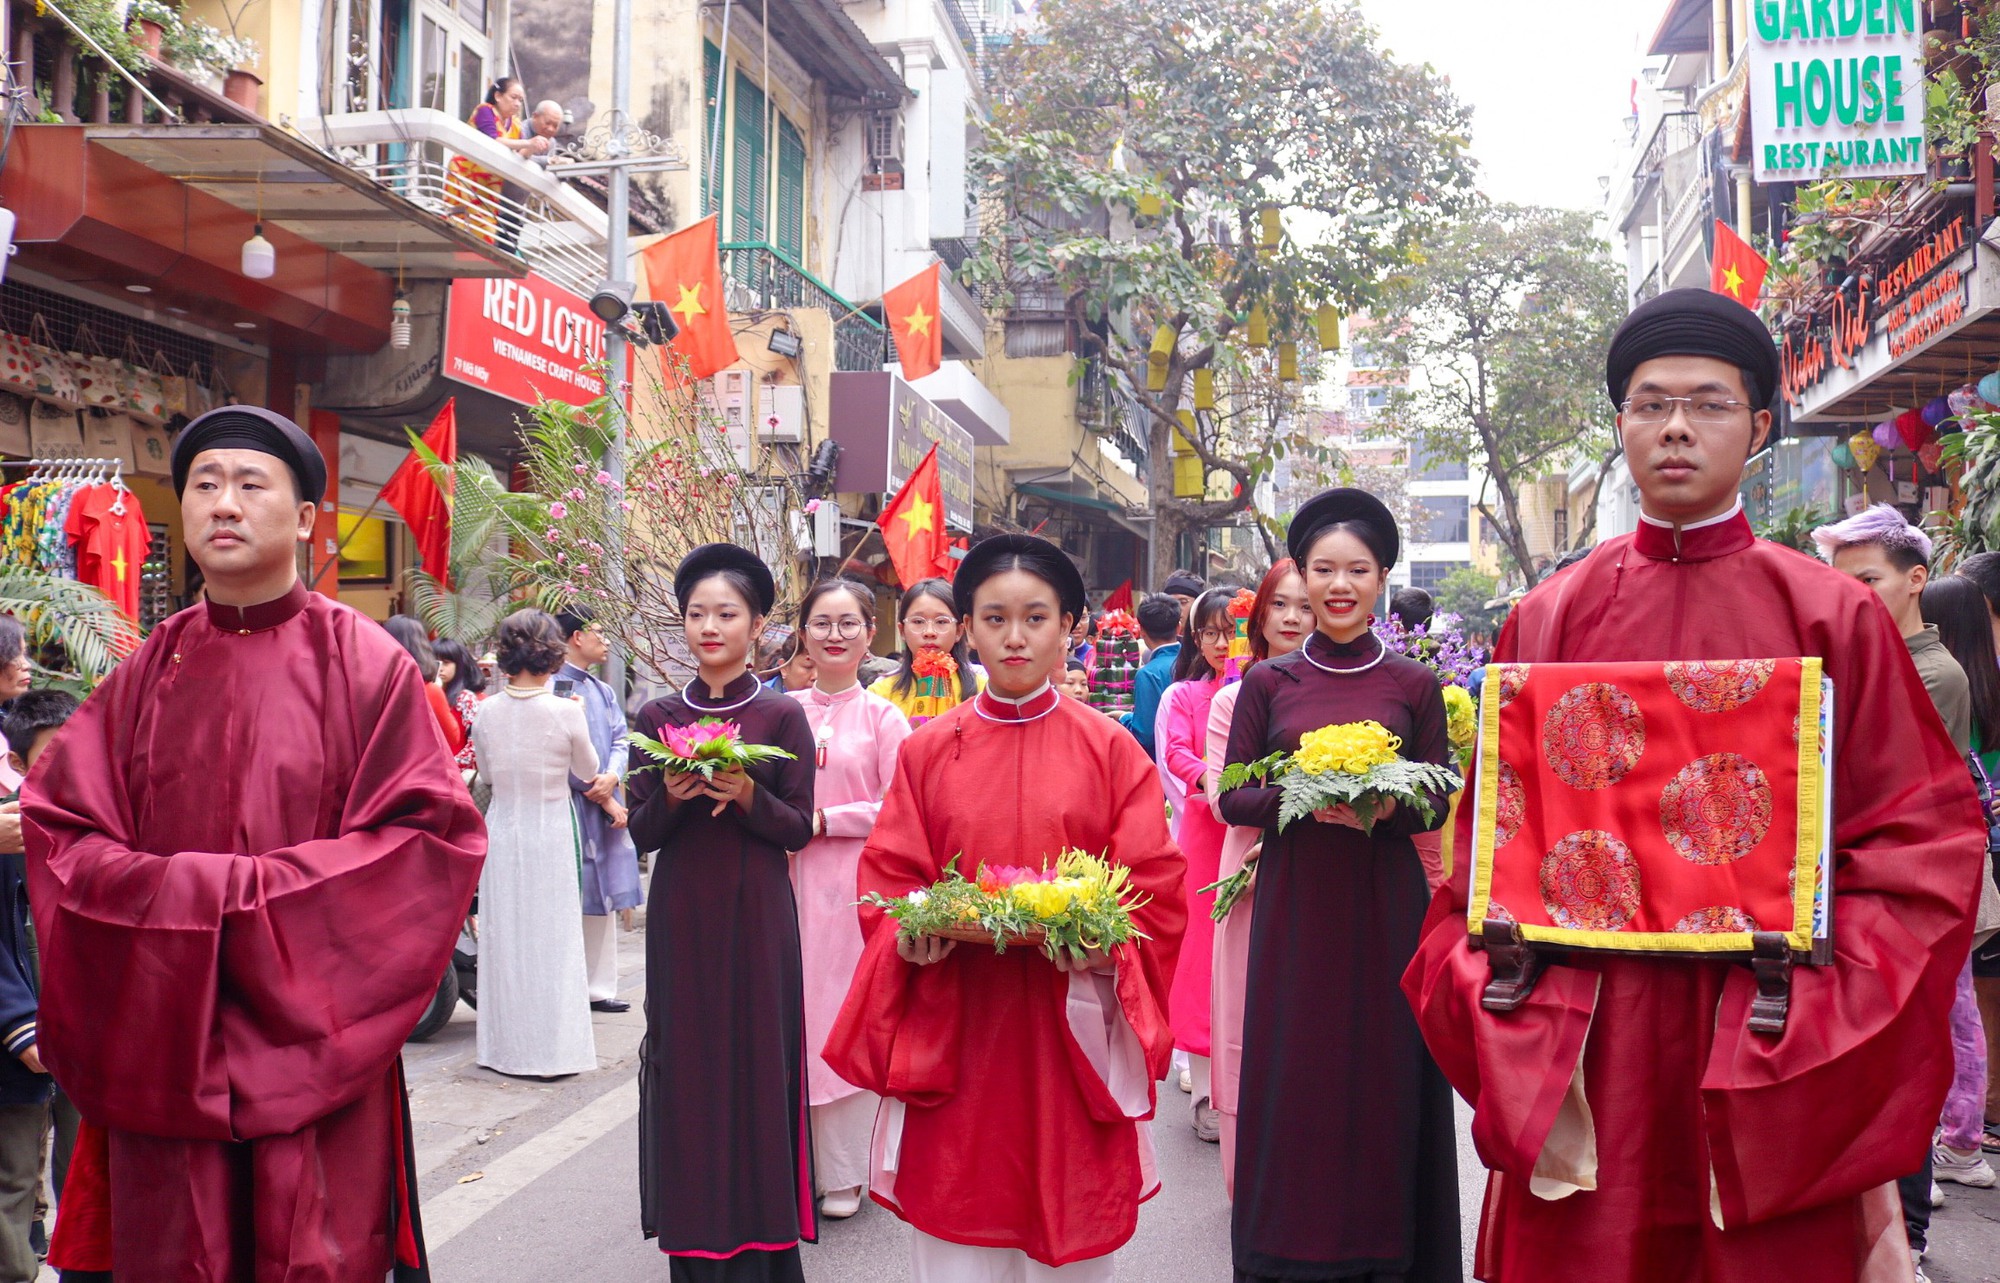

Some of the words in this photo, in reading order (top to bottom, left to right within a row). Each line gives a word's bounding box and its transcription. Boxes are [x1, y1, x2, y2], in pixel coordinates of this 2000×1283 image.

[1754, 0, 1915, 42] GARDEN
[1774, 55, 1905, 128] HOUSE
[1763, 136, 1923, 171] RESTAURANT
[1878, 215, 1964, 307] RESTAURANT
[483, 278, 537, 337] RED
[453, 356, 463, 372] 79
[493, 336, 548, 374] VIETNAMESE
[548, 361, 574, 384] CRAFT
[574, 371, 602, 396] HOUSE
